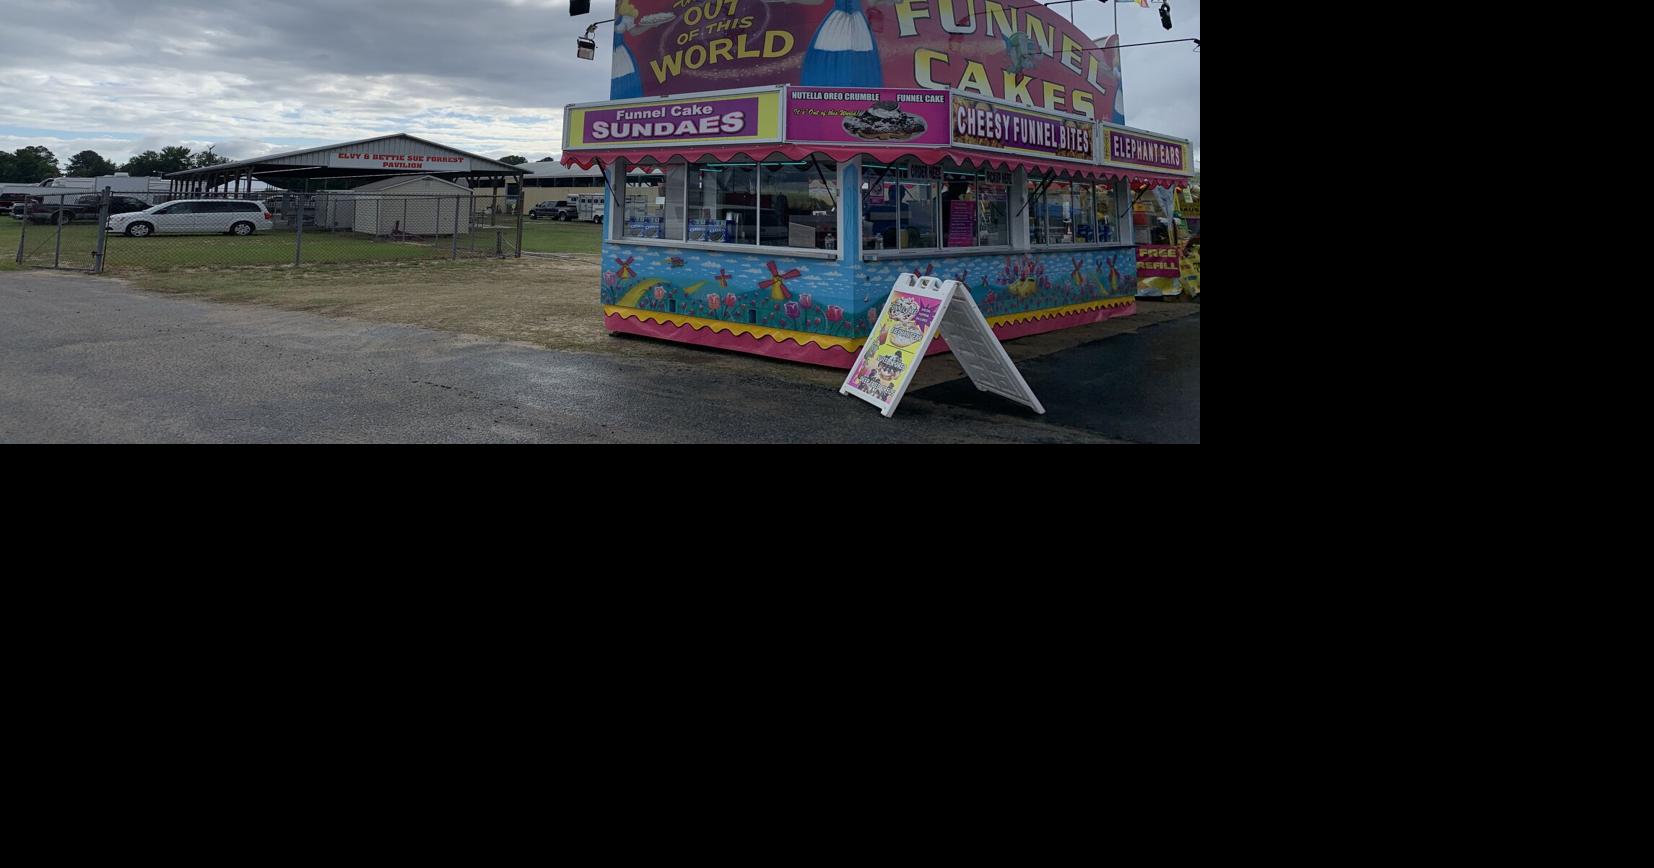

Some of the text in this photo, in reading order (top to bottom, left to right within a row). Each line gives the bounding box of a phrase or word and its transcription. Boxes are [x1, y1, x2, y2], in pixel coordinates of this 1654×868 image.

[683, 0, 738, 26] OUT
[676, 16, 754, 46] OF THIS
[650, 30, 795, 84] WORLD
[895, 0, 1106, 94] FUNNEL
[792, 91, 944, 103] NUTELLA OREO CRUMBLE FUNNEL CAKE
[914, 48, 1096, 120] CAKES
[591, 111, 745, 140] SUNDAES
[616, 104, 713, 120] Funnel Cake
[957, 106, 1089, 153] CHEESY FUNNEL BITES
[1113, 135, 1180, 166] ELEPHANT EARS
[1136, 262, 1178, 271] REFILL
[1139, 248, 1177, 258] FREE
